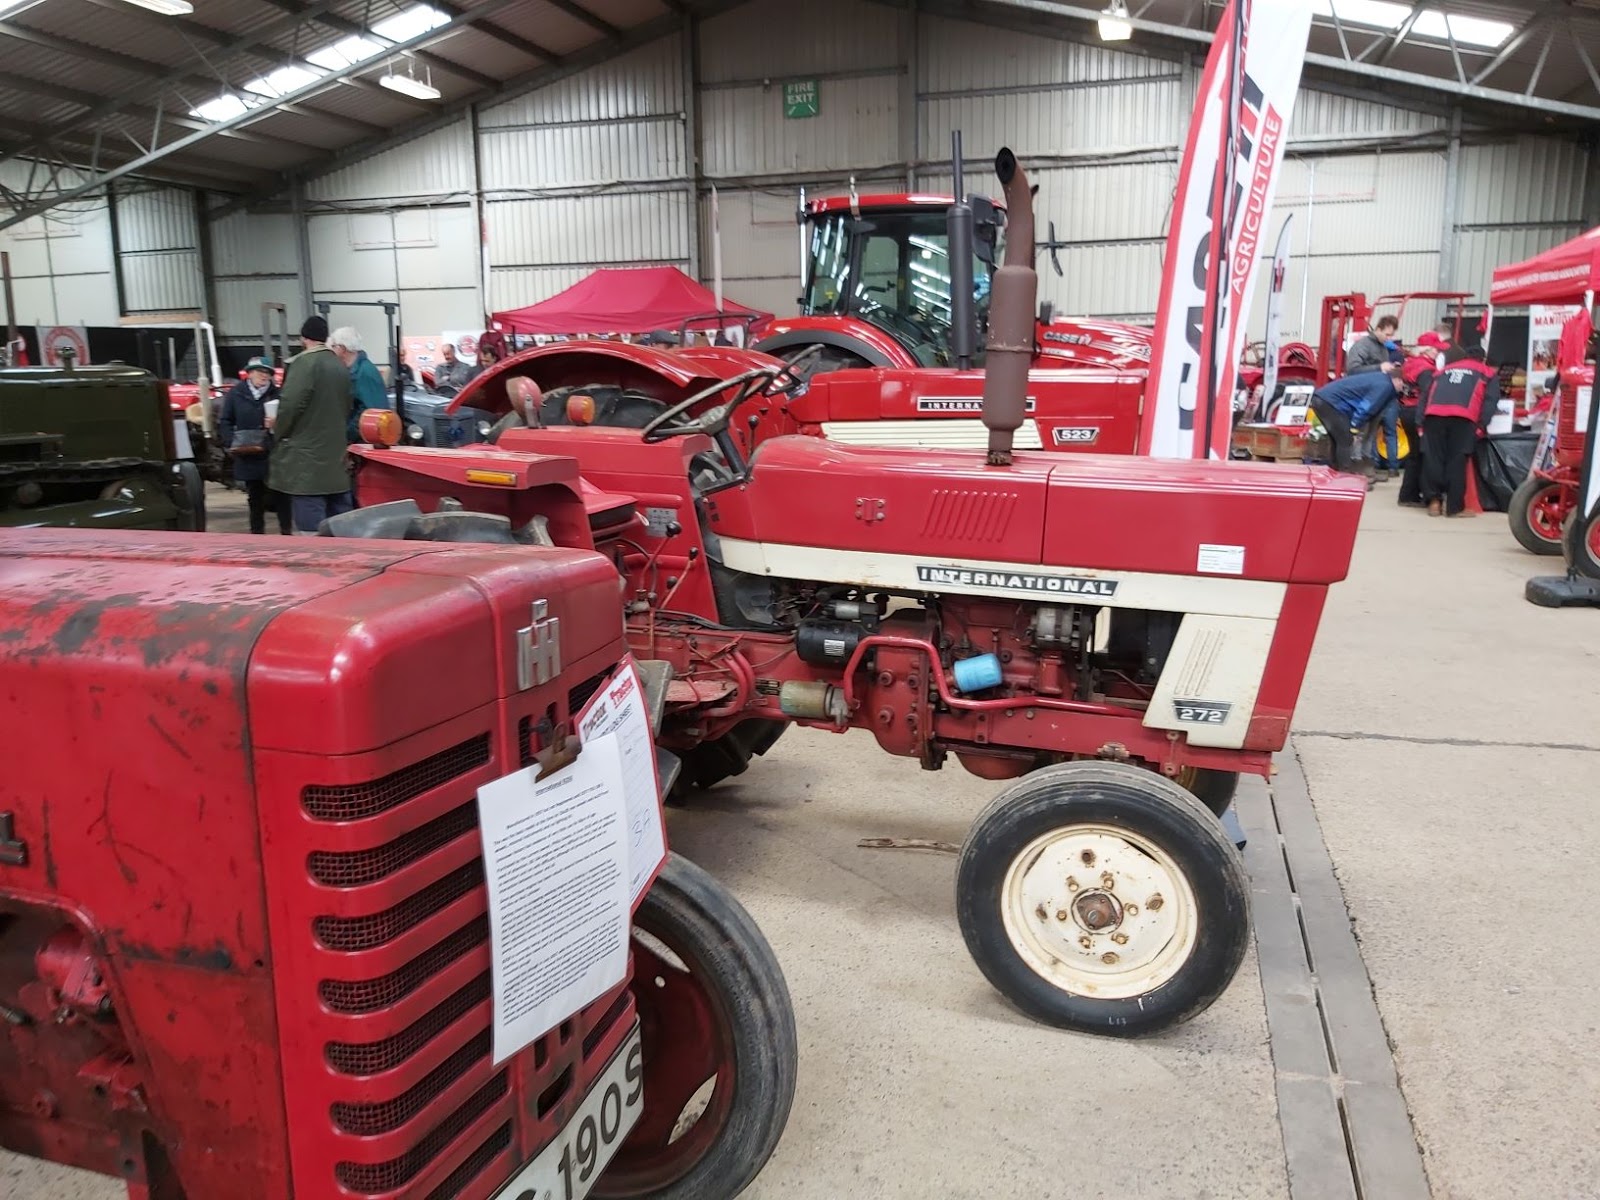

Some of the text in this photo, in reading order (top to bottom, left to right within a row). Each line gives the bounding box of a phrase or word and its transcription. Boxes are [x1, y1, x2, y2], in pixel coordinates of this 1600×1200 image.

[787, 81, 814, 94] FIRE
[787, 92, 815, 105] EXIT
[1231, 115, 1281, 295] AGRICULTURE
[1043, 331, 1080, 345] CASE
[927, 401, 983, 410] INTERNA
[1061, 429, 1091, 439] 523
[920, 568, 1112, 594] INTERNATIONAL
[1179, 708, 1222, 722] 272
